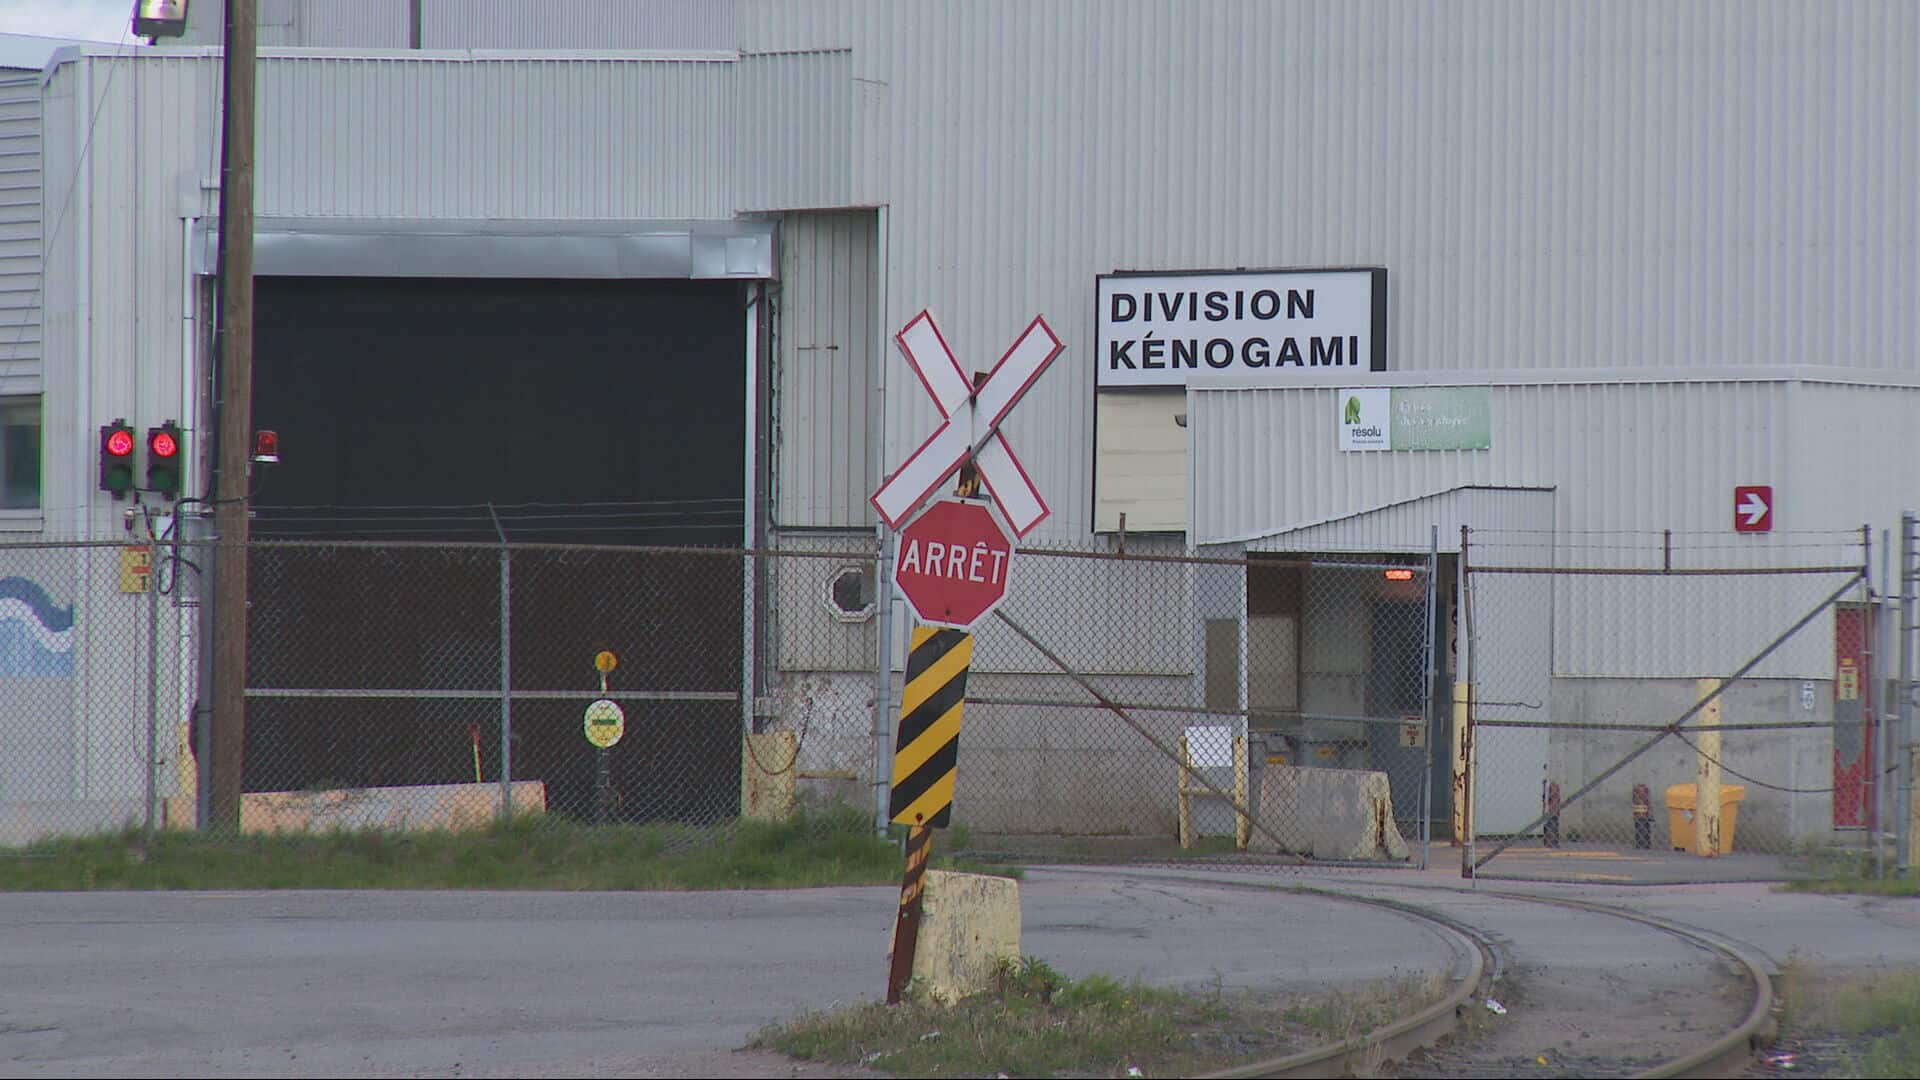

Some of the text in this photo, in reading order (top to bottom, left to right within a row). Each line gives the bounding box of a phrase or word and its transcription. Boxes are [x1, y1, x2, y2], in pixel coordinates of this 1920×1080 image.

[1111, 289, 1315, 323] DIVISION
[1110, 330, 1358, 370] KÉNOGAMI
[1352, 425, 1381, 437] résolu
[901, 539, 1006, 584] ARRÊT
